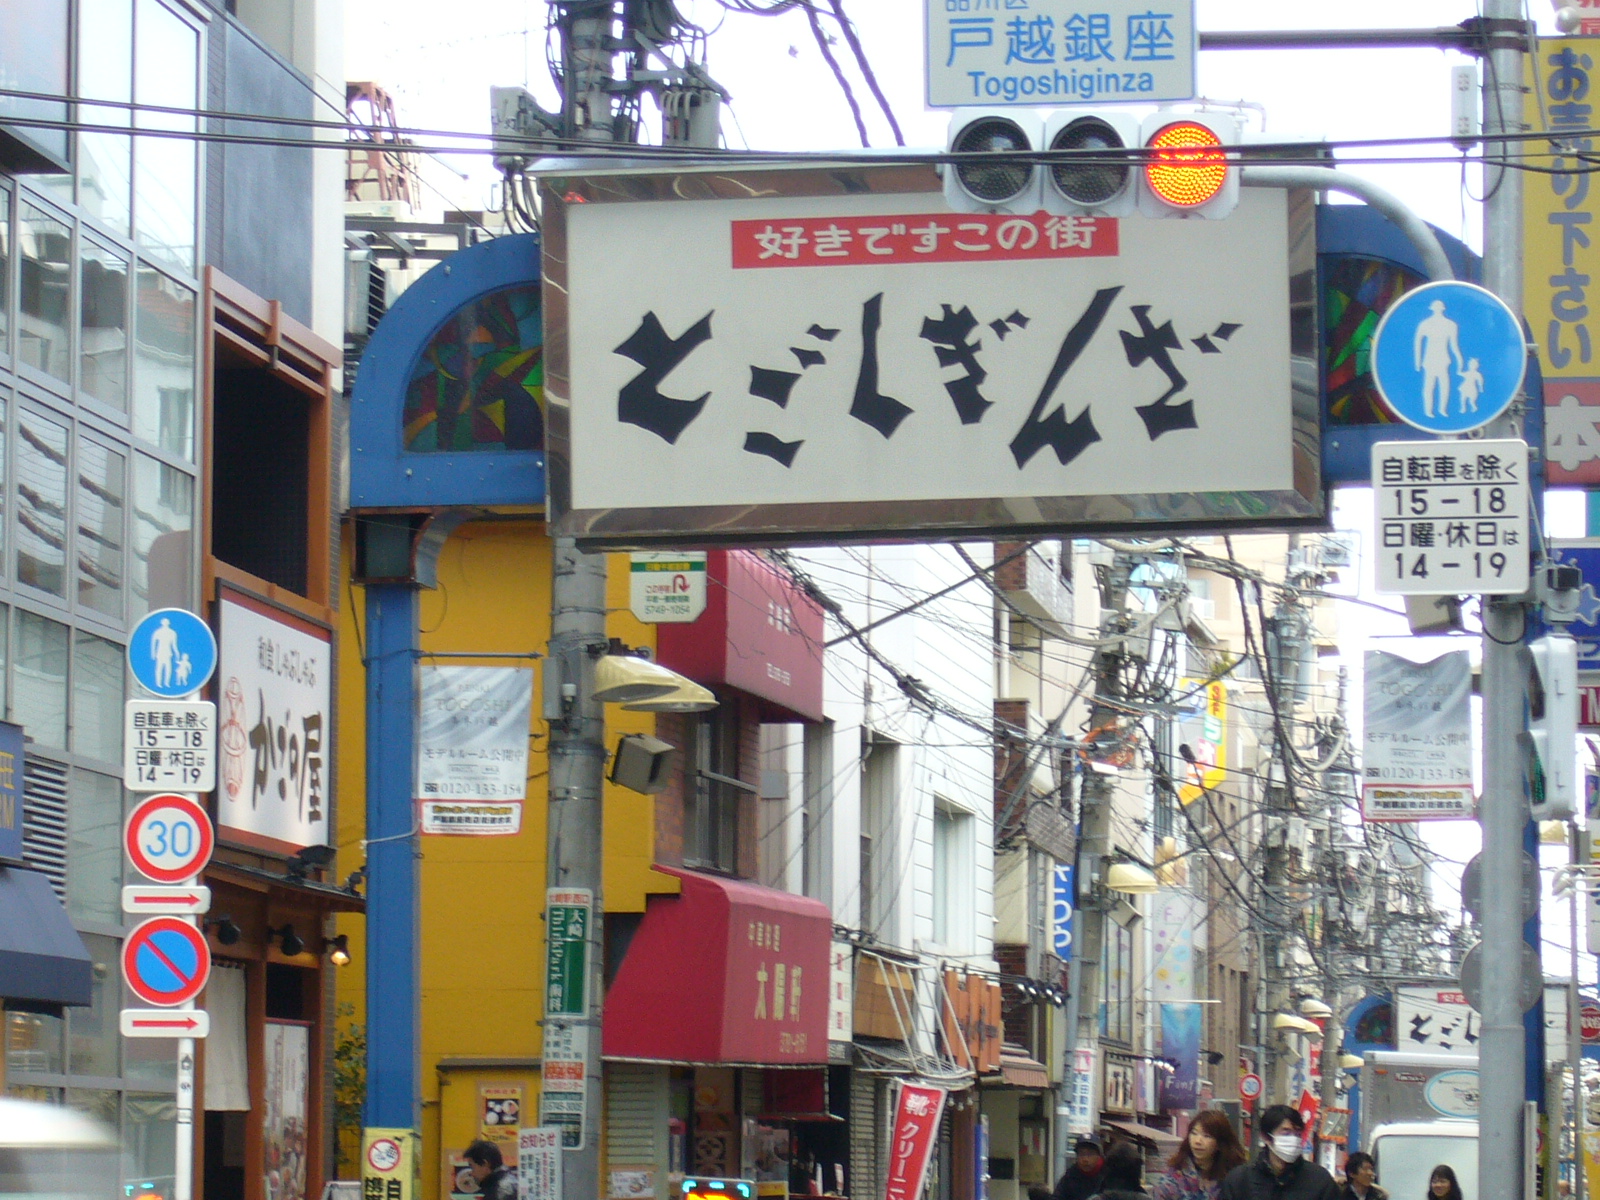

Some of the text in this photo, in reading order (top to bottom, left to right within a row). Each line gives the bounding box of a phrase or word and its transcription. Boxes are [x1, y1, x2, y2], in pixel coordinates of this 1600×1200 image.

[946, 10, 1175, 66] 戸越銀座
[967, 68, 1154, 101] Togoshiginza
[754, 215, 1098, 260] 好きですこの街
[613, 285, 1243, 470] とごしぎんざ
[1382, 454, 1518, 482] 自転車を除く
[133, 711, 208, 729] 自転車を除く
[146, 820, 193, 857] 30
